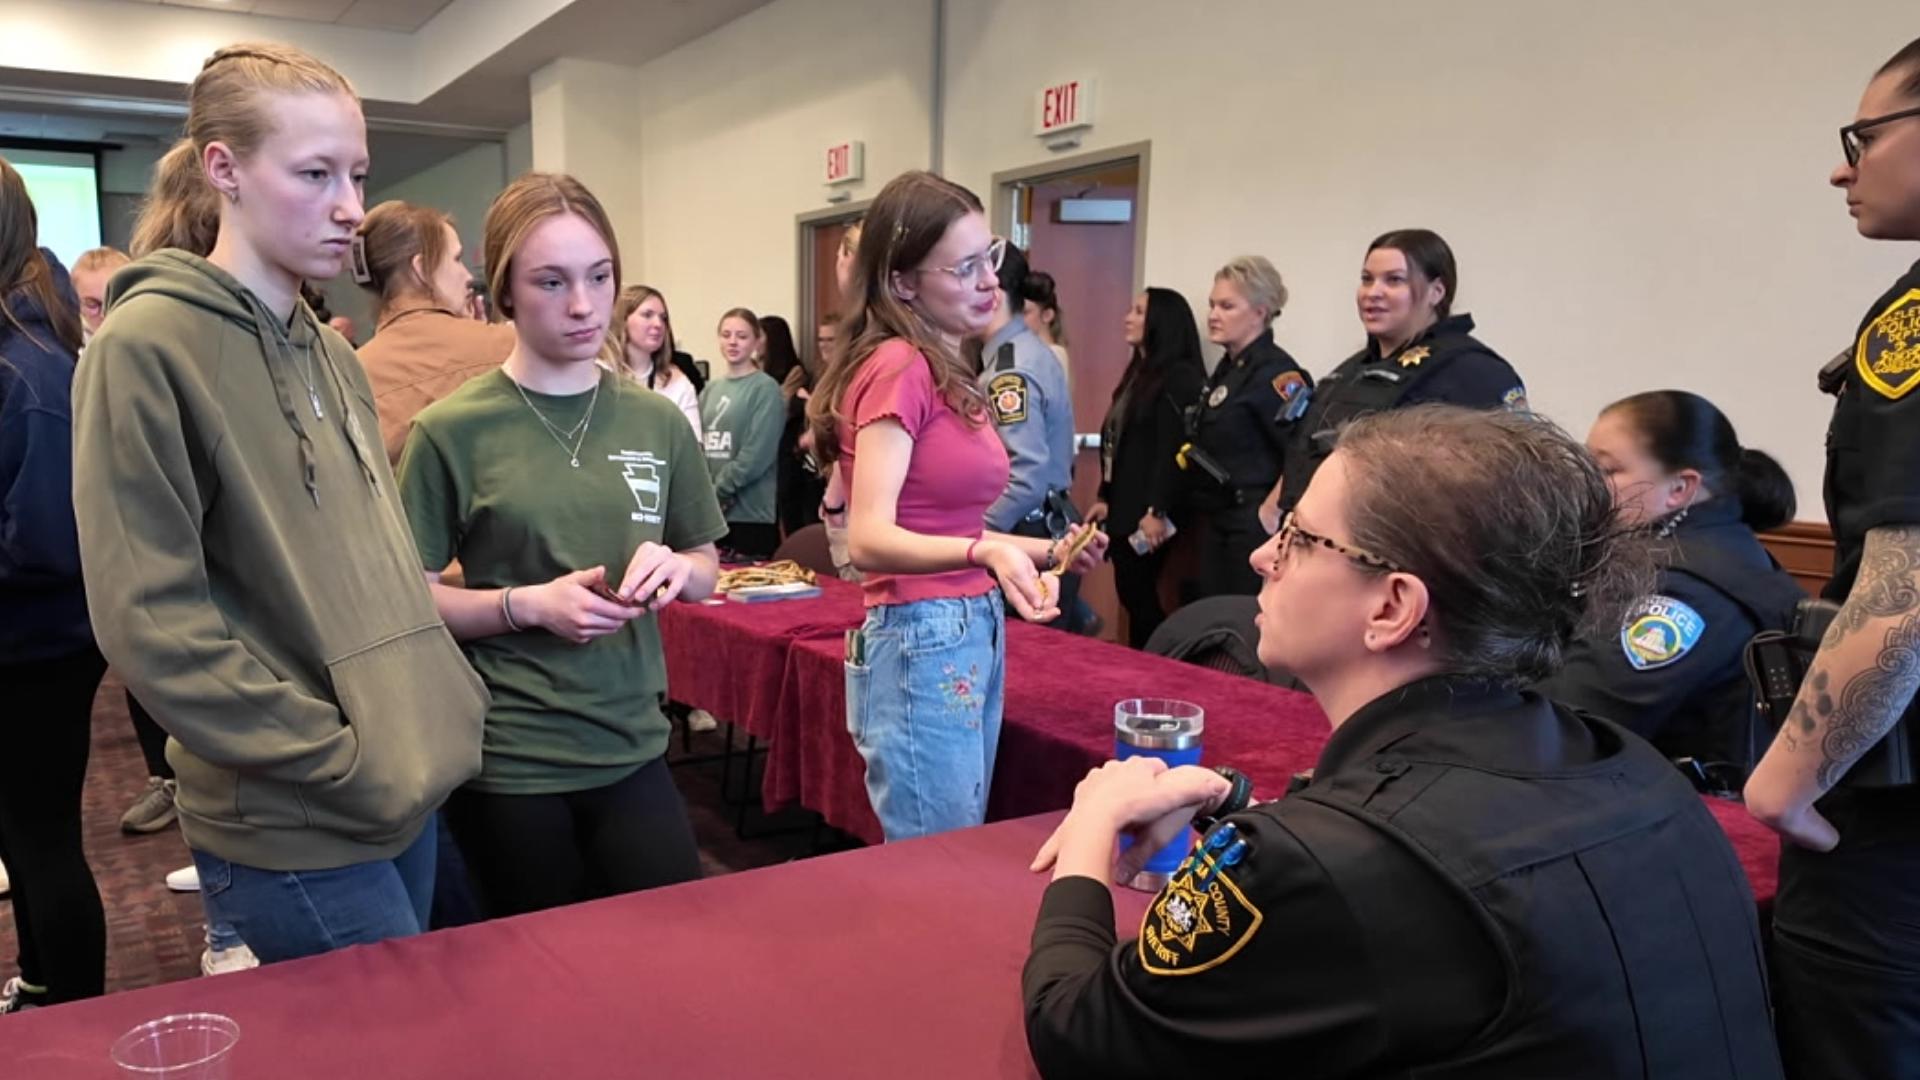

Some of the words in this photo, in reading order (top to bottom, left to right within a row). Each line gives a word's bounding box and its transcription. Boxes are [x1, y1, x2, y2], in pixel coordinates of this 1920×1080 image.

[1043, 82, 1079, 129] EXIT
[827, 144, 849, 180] EXIT
[1208, 882, 1230, 936] COUNTY
[1146, 924, 1180, 967] SHERIFF
